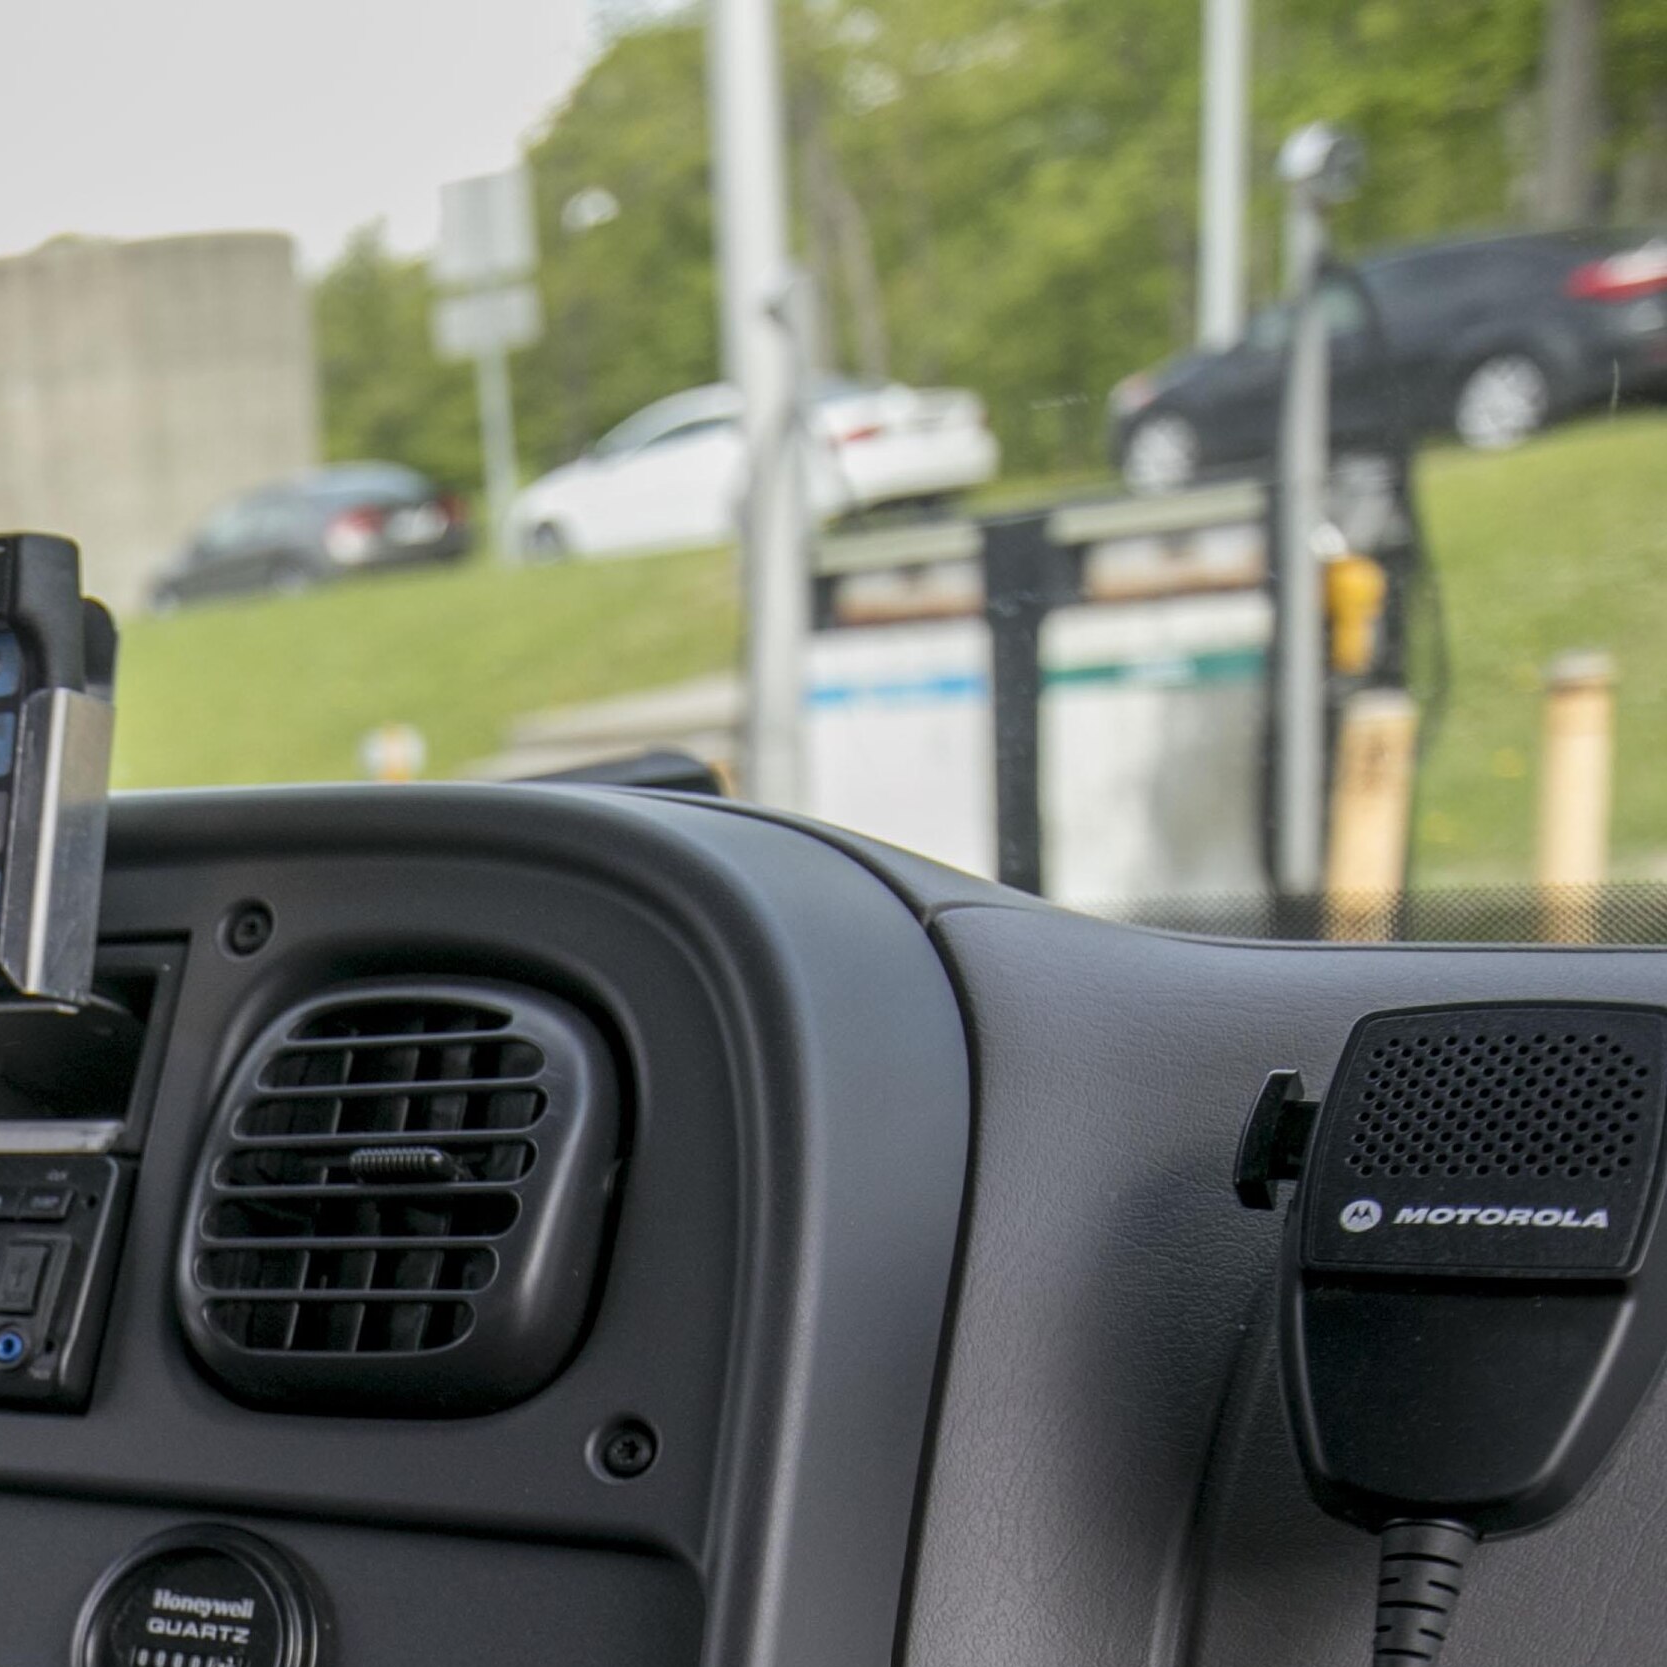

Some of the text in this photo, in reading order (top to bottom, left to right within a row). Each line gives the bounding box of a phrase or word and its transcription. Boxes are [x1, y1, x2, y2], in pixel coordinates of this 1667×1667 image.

[1392, 1206, 1609, 1229] MOTOROLA
[152, 1587, 255, 1619] Honeywell
[147, 1616, 251, 1645] QUARTZ
